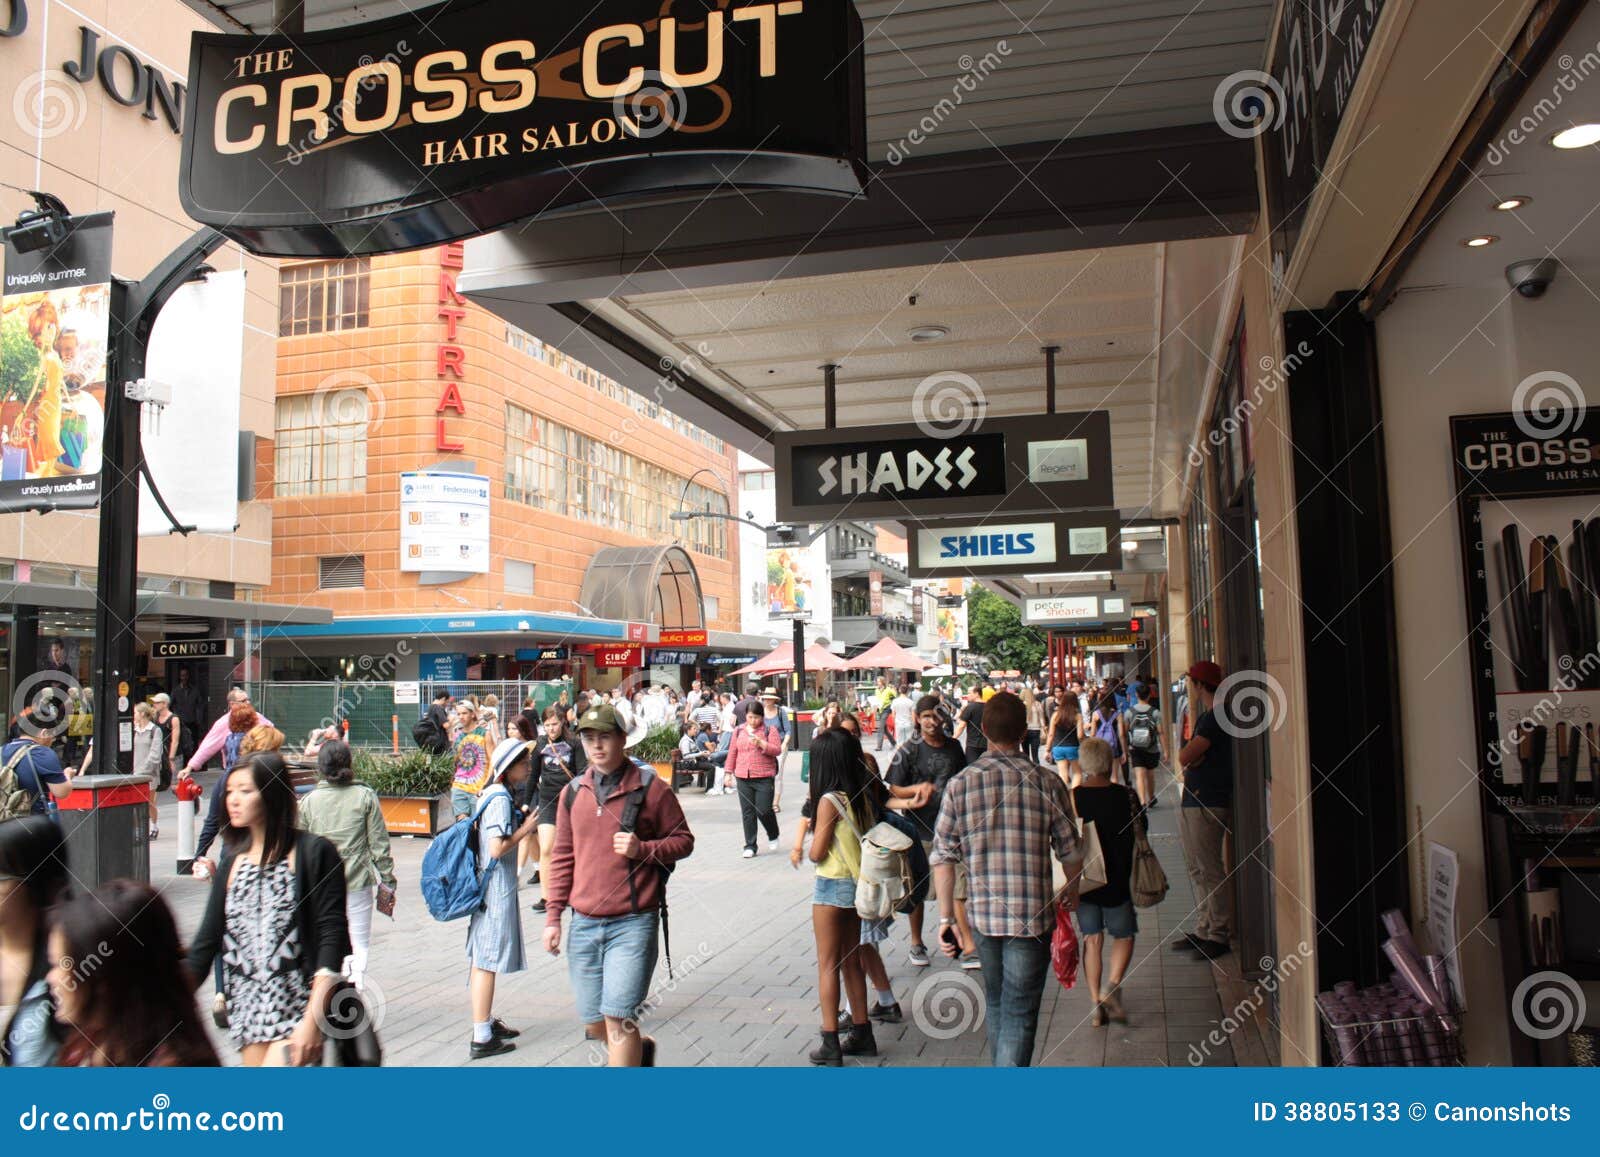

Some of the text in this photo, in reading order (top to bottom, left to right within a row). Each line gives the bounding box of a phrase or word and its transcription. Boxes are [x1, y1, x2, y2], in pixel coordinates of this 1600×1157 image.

[234, 48, 294, 78] THE
[214, 0, 803, 155] CROSS CUT
[422, 113, 644, 167] HAIR SALON
[7, 271, 46, 286] Uniquely
[1482, 431, 1508, 441] THE
[1464, 438, 1592, 471] CROSS
[817, 446, 978, 497] SHADES
[1546, 468, 1600, 480] HAIR SA
[940, 532, 1035, 558] SHIELS
[1034, 601, 1065, 612] peter
[160, 642, 217, 656] CONNOR
[605, 653, 627, 661] CIBO
